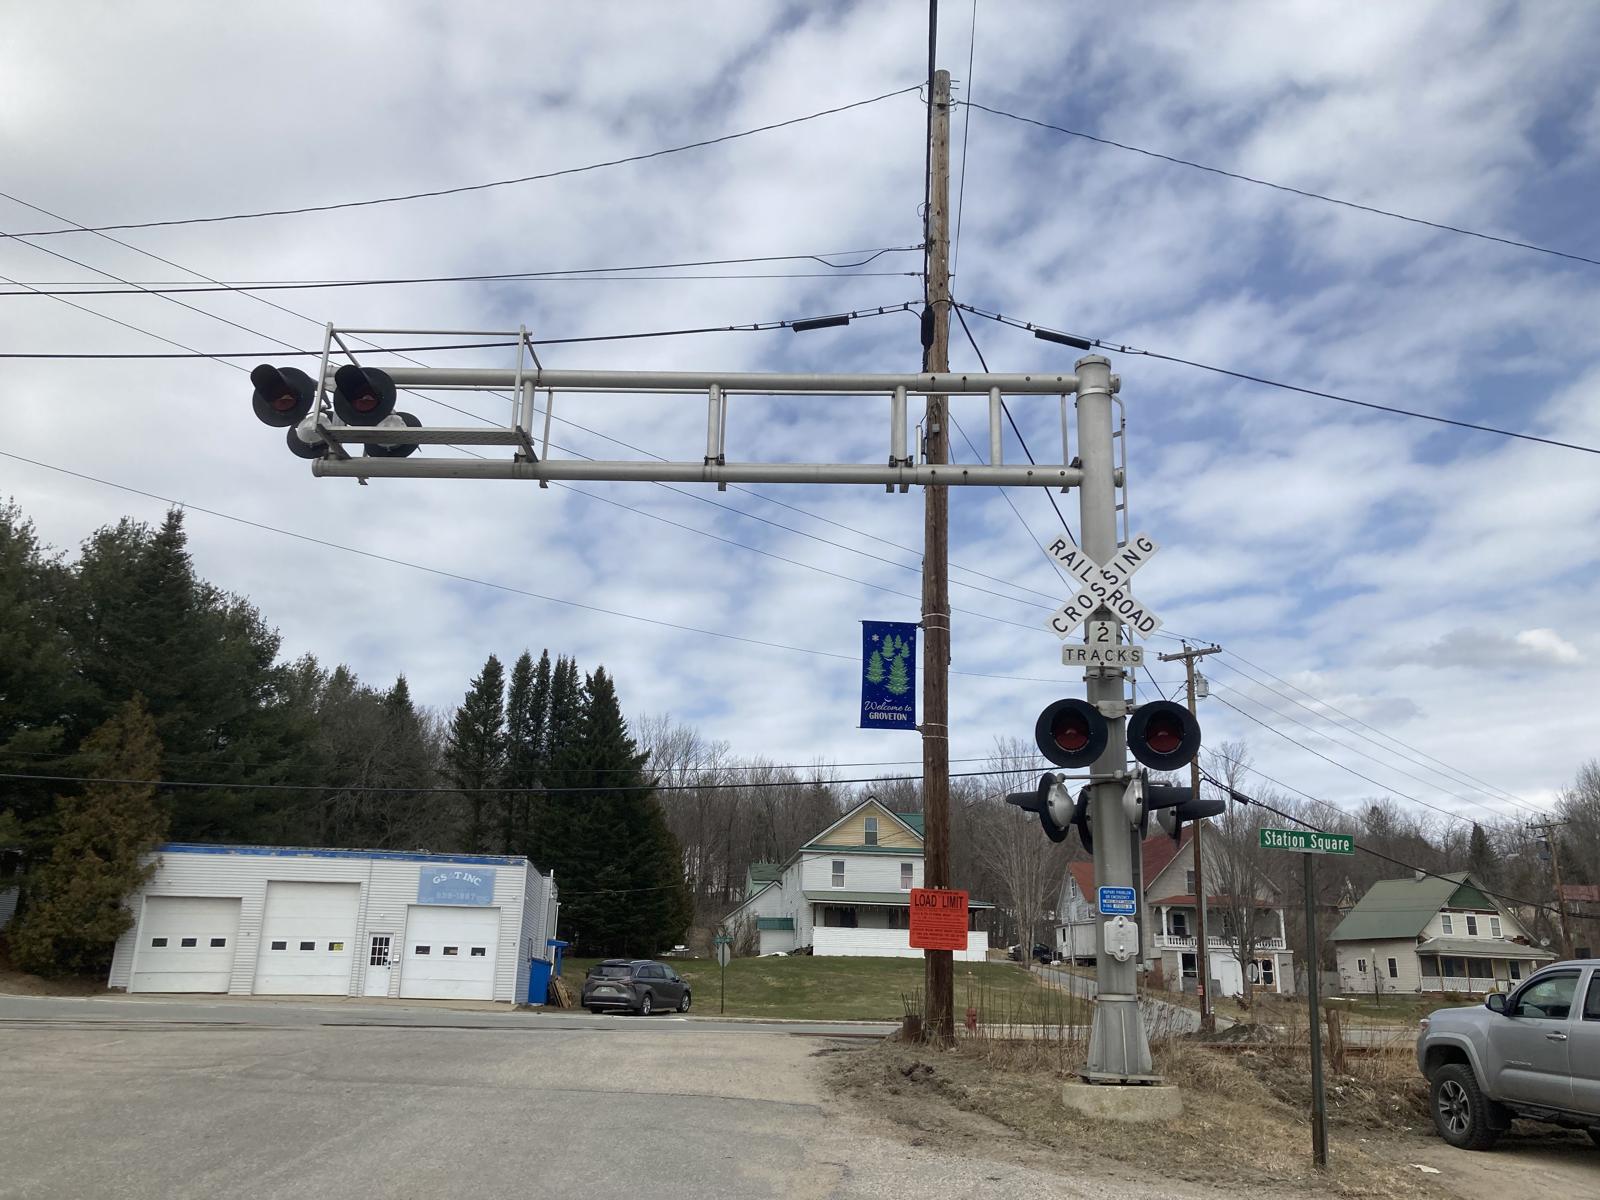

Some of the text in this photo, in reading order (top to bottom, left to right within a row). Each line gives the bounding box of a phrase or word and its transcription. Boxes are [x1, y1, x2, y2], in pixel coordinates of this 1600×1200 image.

[1052, 538, 1153, 633] CROSSING
[1097, 626, 1109, 642] 2
[1065, 649, 1140, 661] TRACKS
[864, 701, 903, 711] Welcome
[869, 711, 907, 720] GROVETON
[1264, 830, 1350, 851] Station Square
[462, 872, 482, 886] INC
[914, 894, 963, 909] LOAD LIMIT
